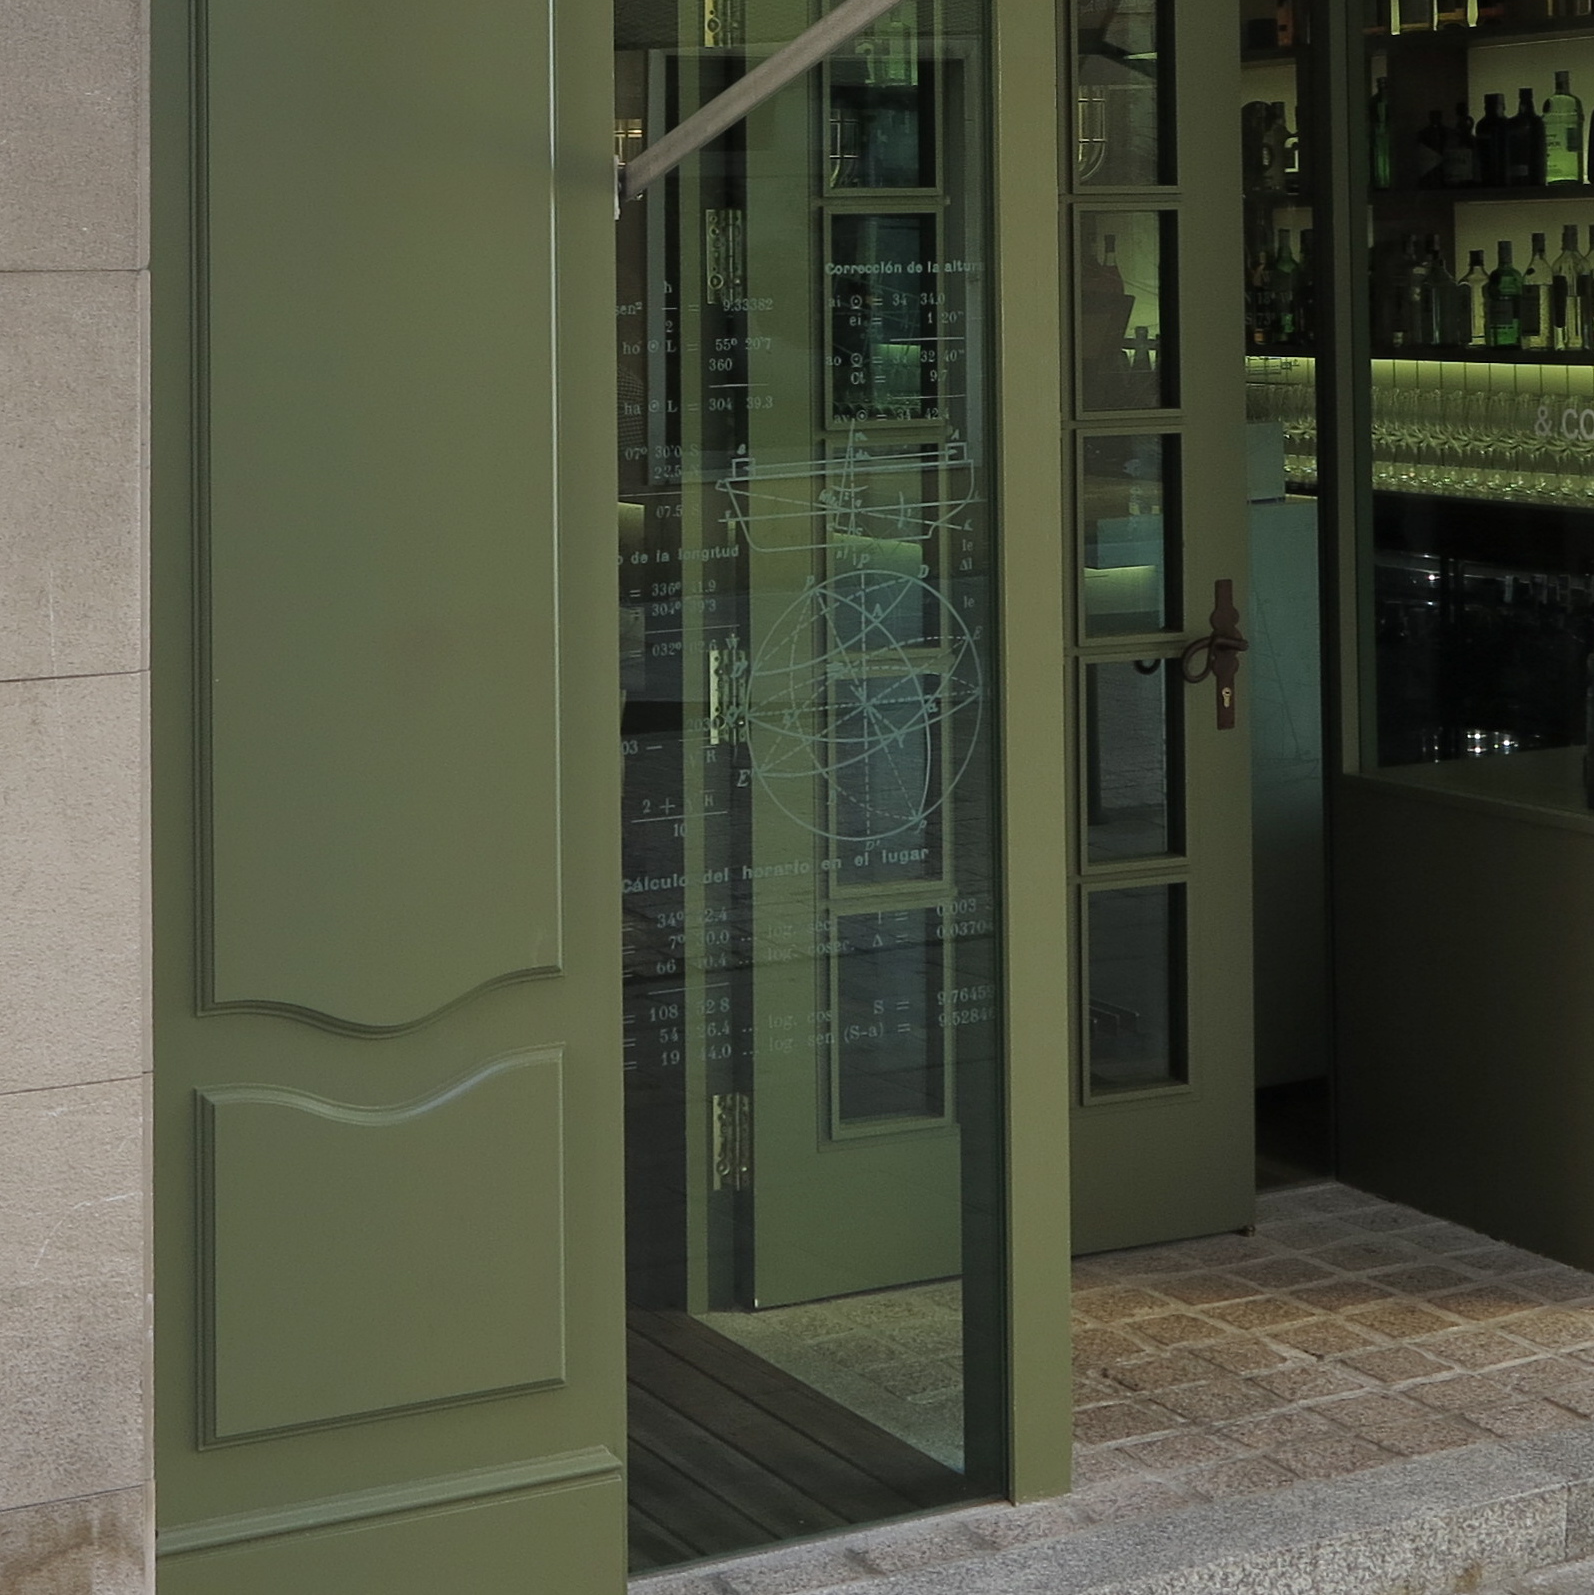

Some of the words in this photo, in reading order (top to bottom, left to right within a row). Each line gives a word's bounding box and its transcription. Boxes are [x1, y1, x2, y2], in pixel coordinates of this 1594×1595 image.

[906, 261, 923, 274] de
[708, 357, 733, 372] 360
[1534, 405, 1552, 437] &
[678, 544, 740, 563] longitud
[622, 872, 689, 893] Cálculo
[703, 867, 729, 884] del
[820, 857, 842, 871] en
[881, 846, 930, 865] lugar
[649, 1003, 679, 1023] 108
